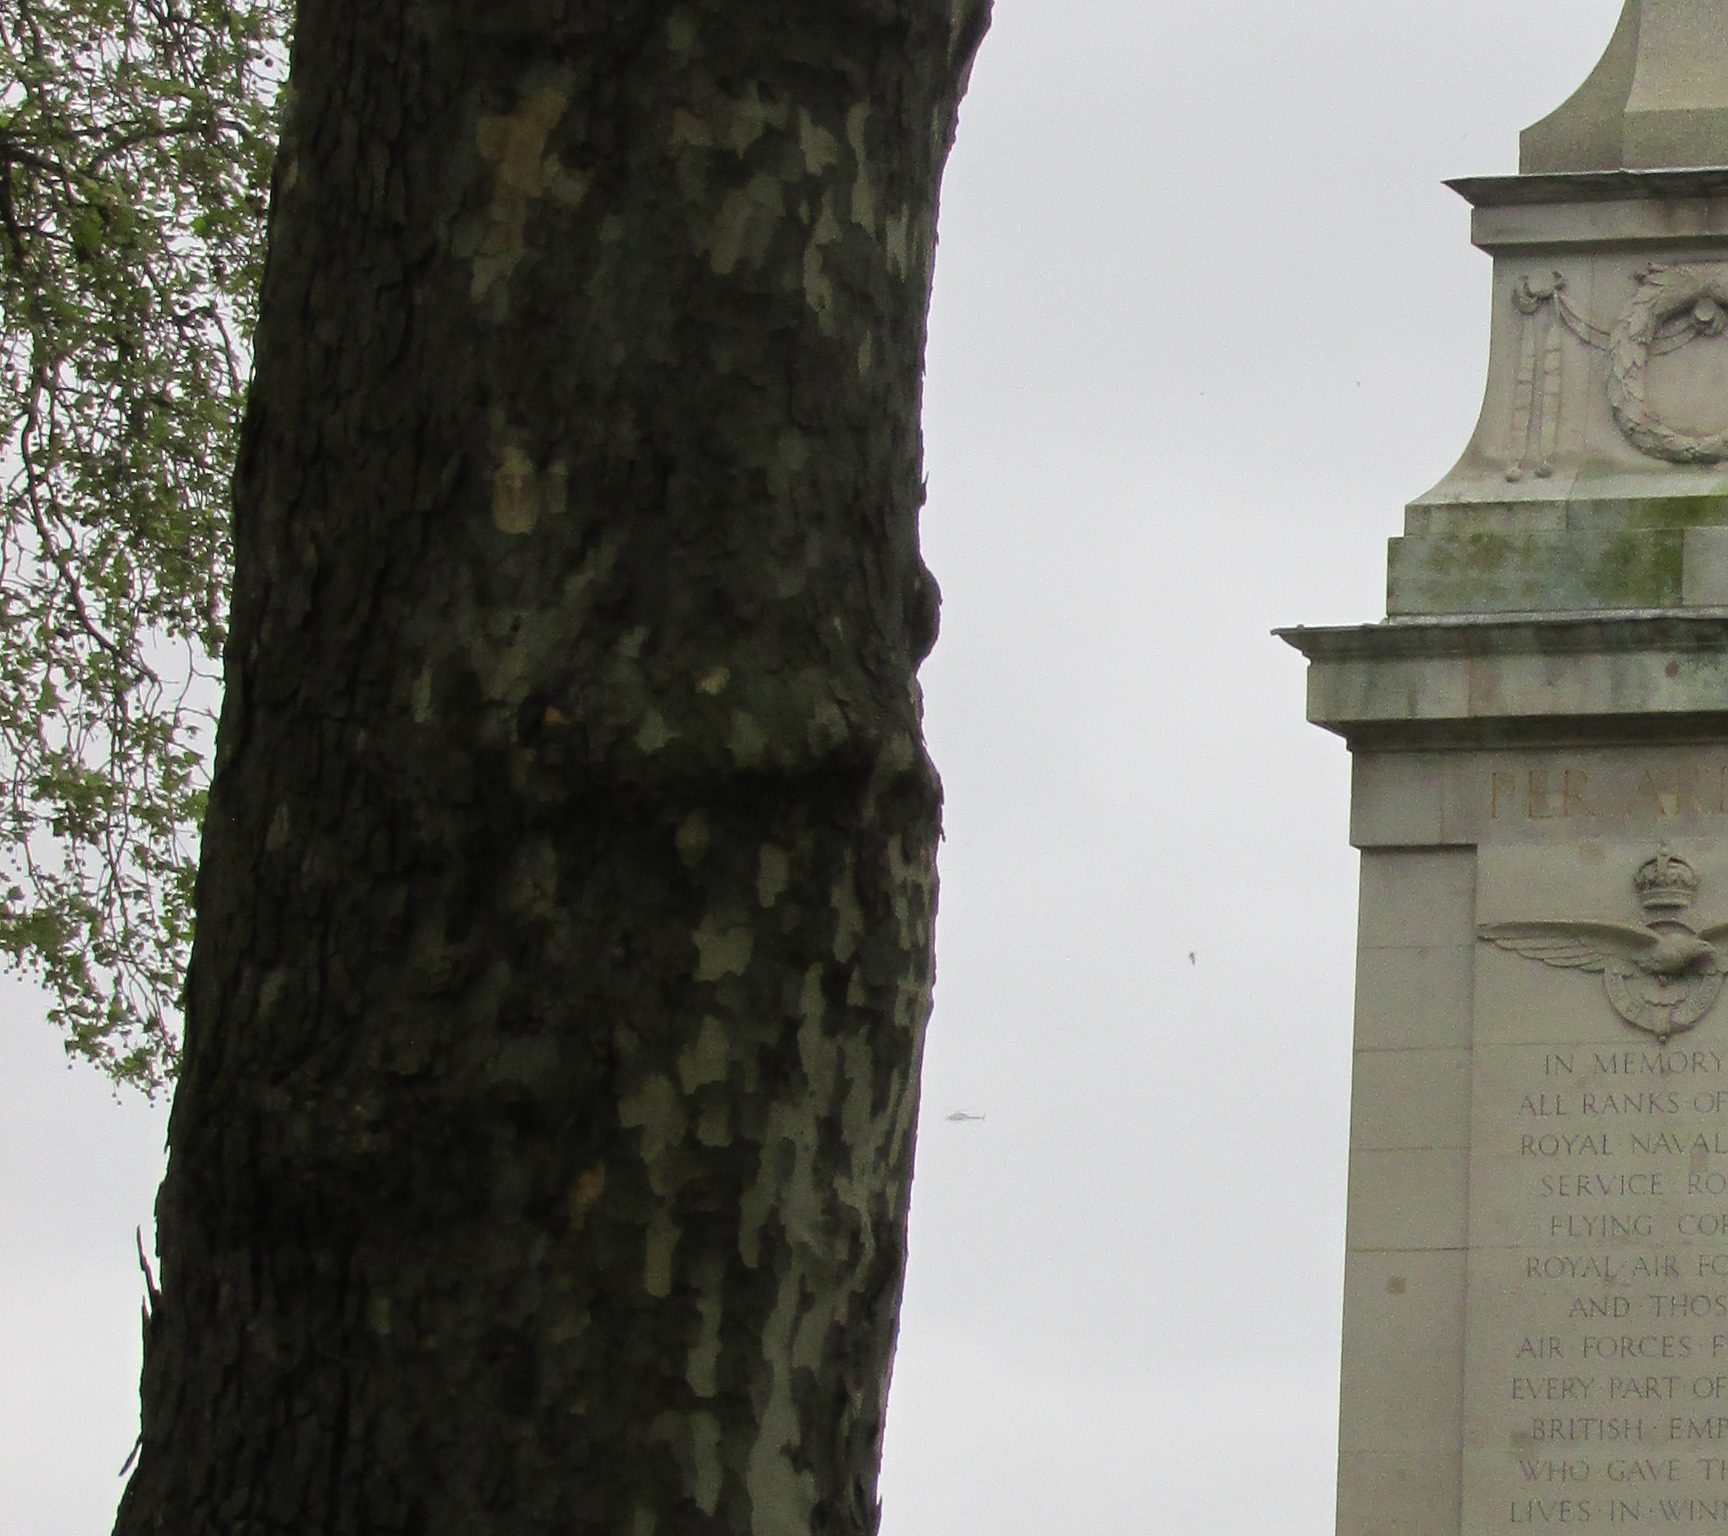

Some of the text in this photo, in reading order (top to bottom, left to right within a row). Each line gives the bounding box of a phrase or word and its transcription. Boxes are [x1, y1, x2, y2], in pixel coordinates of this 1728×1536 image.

[1492, 769, 1597, 820] PER
[1545, 1054, 1574, 1075] IN
[1594, 1049, 1722, 1074] MEMORY
[1519, 1094, 1567, 1116] ALL
[1582, 1092, 1680, 1115] RANKS
[1521, 1133, 1613, 1157] ROYAL
[1630, 1131, 1728, 1154] NAVAL
[1541, 1174, 1663, 1197] SERVICE
[1551, 1214, 1652, 1237] FLYING
[1526, 1255, 1618, 1278] ROYAL
[1633, 1255, 1680, 1278] AIR
[1568, 1296, 1631, 1318] AND
[1516, 1336, 1564, 1359] AIR
[1583, 1335, 1692, 1358] FORCES
[1511, 1377, 1595, 1400] EVERY
[1610, 1376, 1681, 1399] PART
[1692, 1376, 1728, 1399] OF
[1532, 1417, 1643, 1441] BRITISH
[1519, 1460, 1590, 1482] WHO
[1606, 1459, 1680, 1482] GAVE
[1510, 1500, 1591, 1523] LIVES
[1610, 1500, 1640, 1522] IN
